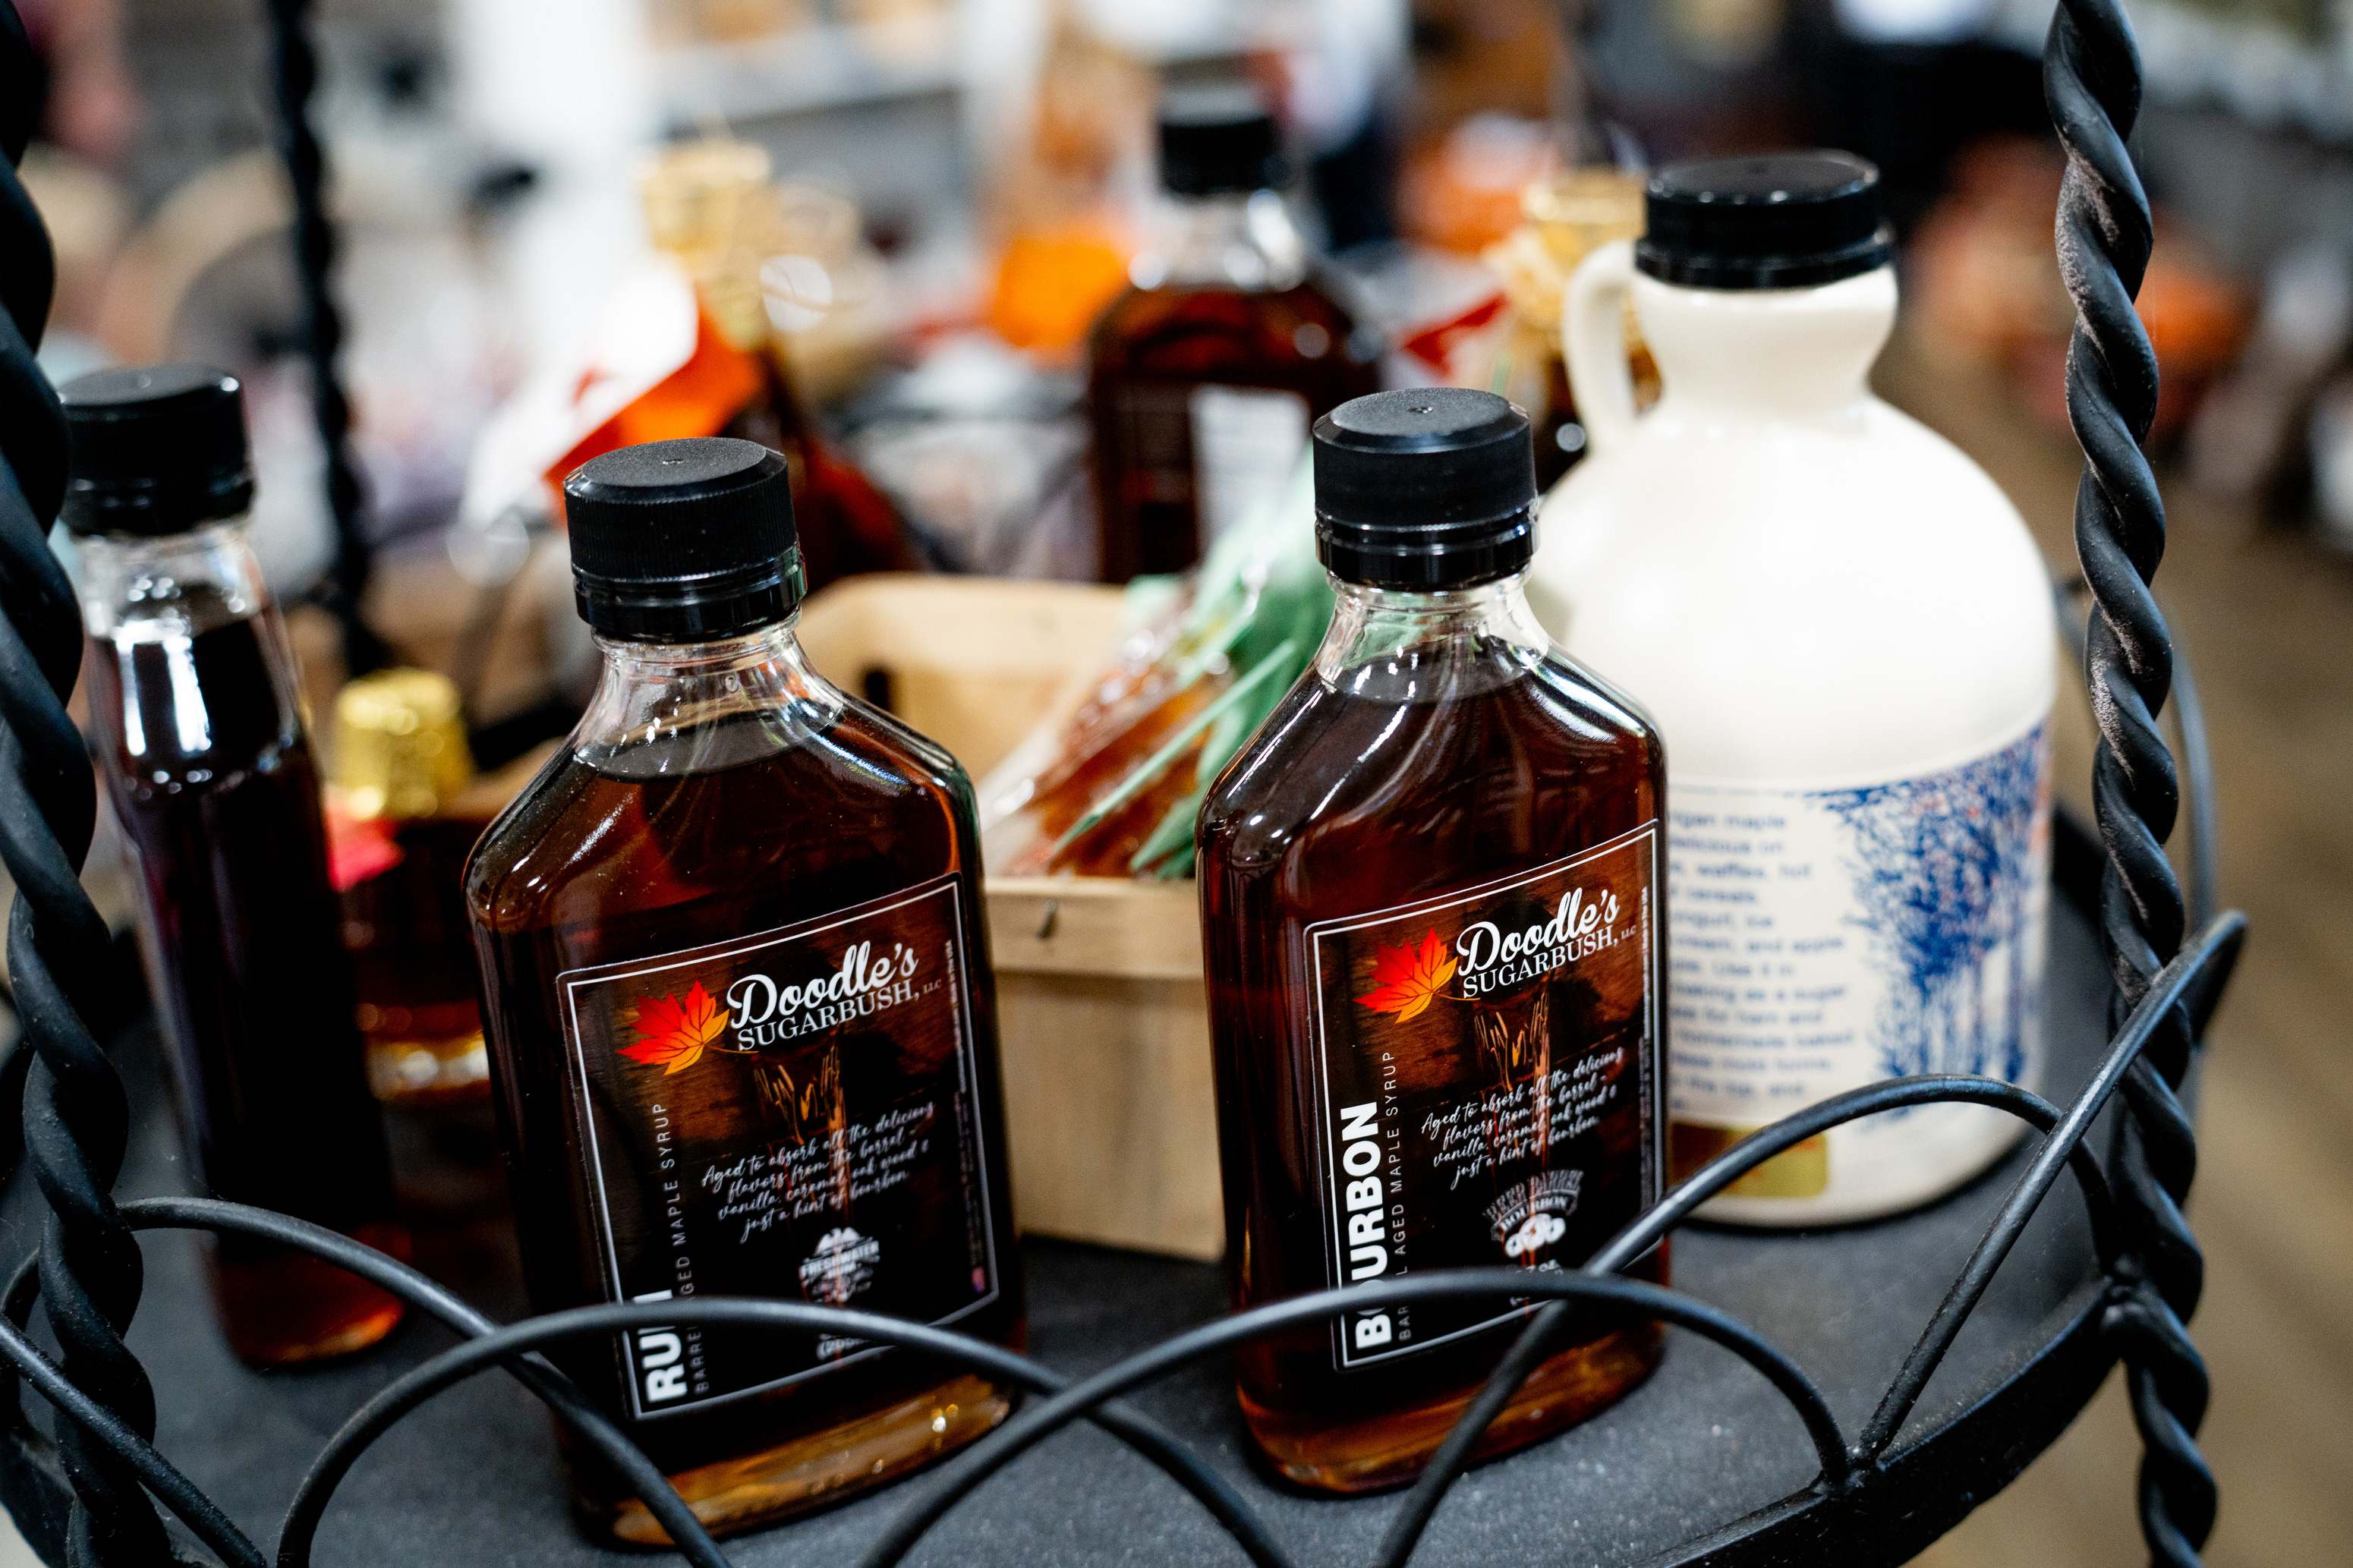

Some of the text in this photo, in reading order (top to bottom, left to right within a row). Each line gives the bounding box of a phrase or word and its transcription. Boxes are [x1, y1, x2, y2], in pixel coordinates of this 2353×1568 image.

[1455, 887, 1621, 977] Doodle's
[1463, 924, 1619, 999] SUGARBUSH,
[1621, 924, 1636, 940] LLC
[726, 940, 918, 1030] Doodle's
[738, 979, 920, 1051] SUGARBUSH,
[923, 978, 942, 993] LLC
[1421, 1046, 1625, 1141] Aged to absorb all the delicious
[1442, 1118, 1497, 1151] flavors
[1498, 1107, 1532, 1133] from
[1533, 1094, 1556, 1116] the
[1558, 1072, 1598, 1105] barrel
[1551, 1101, 1573, 1125] oak
[1575, 1085, 1608, 1116] wood
[701, 1157, 746, 1194] Aged
[747, 1154, 765, 1176] to
[768, 1137, 819, 1167] absorb
[823, 1128, 846, 1150] all
[847, 1122, 872, 1145] the
[727, 1173, 789, 1204] flavors
[790, 1161, 830, 1187] from
[830, 1148, 856, 1169] the
[1450, 1154, 1490, 1191] just
[1486, 1157, 1496, 1167] a
[1498, 1138, 1534, 1166] hint
[1530, 1132, 1545, 1156] of
[739, 1207, 783, 1245] just
[792, 1192, 834, 1220] hint
[829, 1186, 846, 1211] of
[1340, 1100, 1392, 1349] BURBON
[1382, 1052, 1412, 1342] BARL AGED MAPLE SYRUP
[652, 1104, 710, 1395] BARRE GED MAPLE SYRUP
